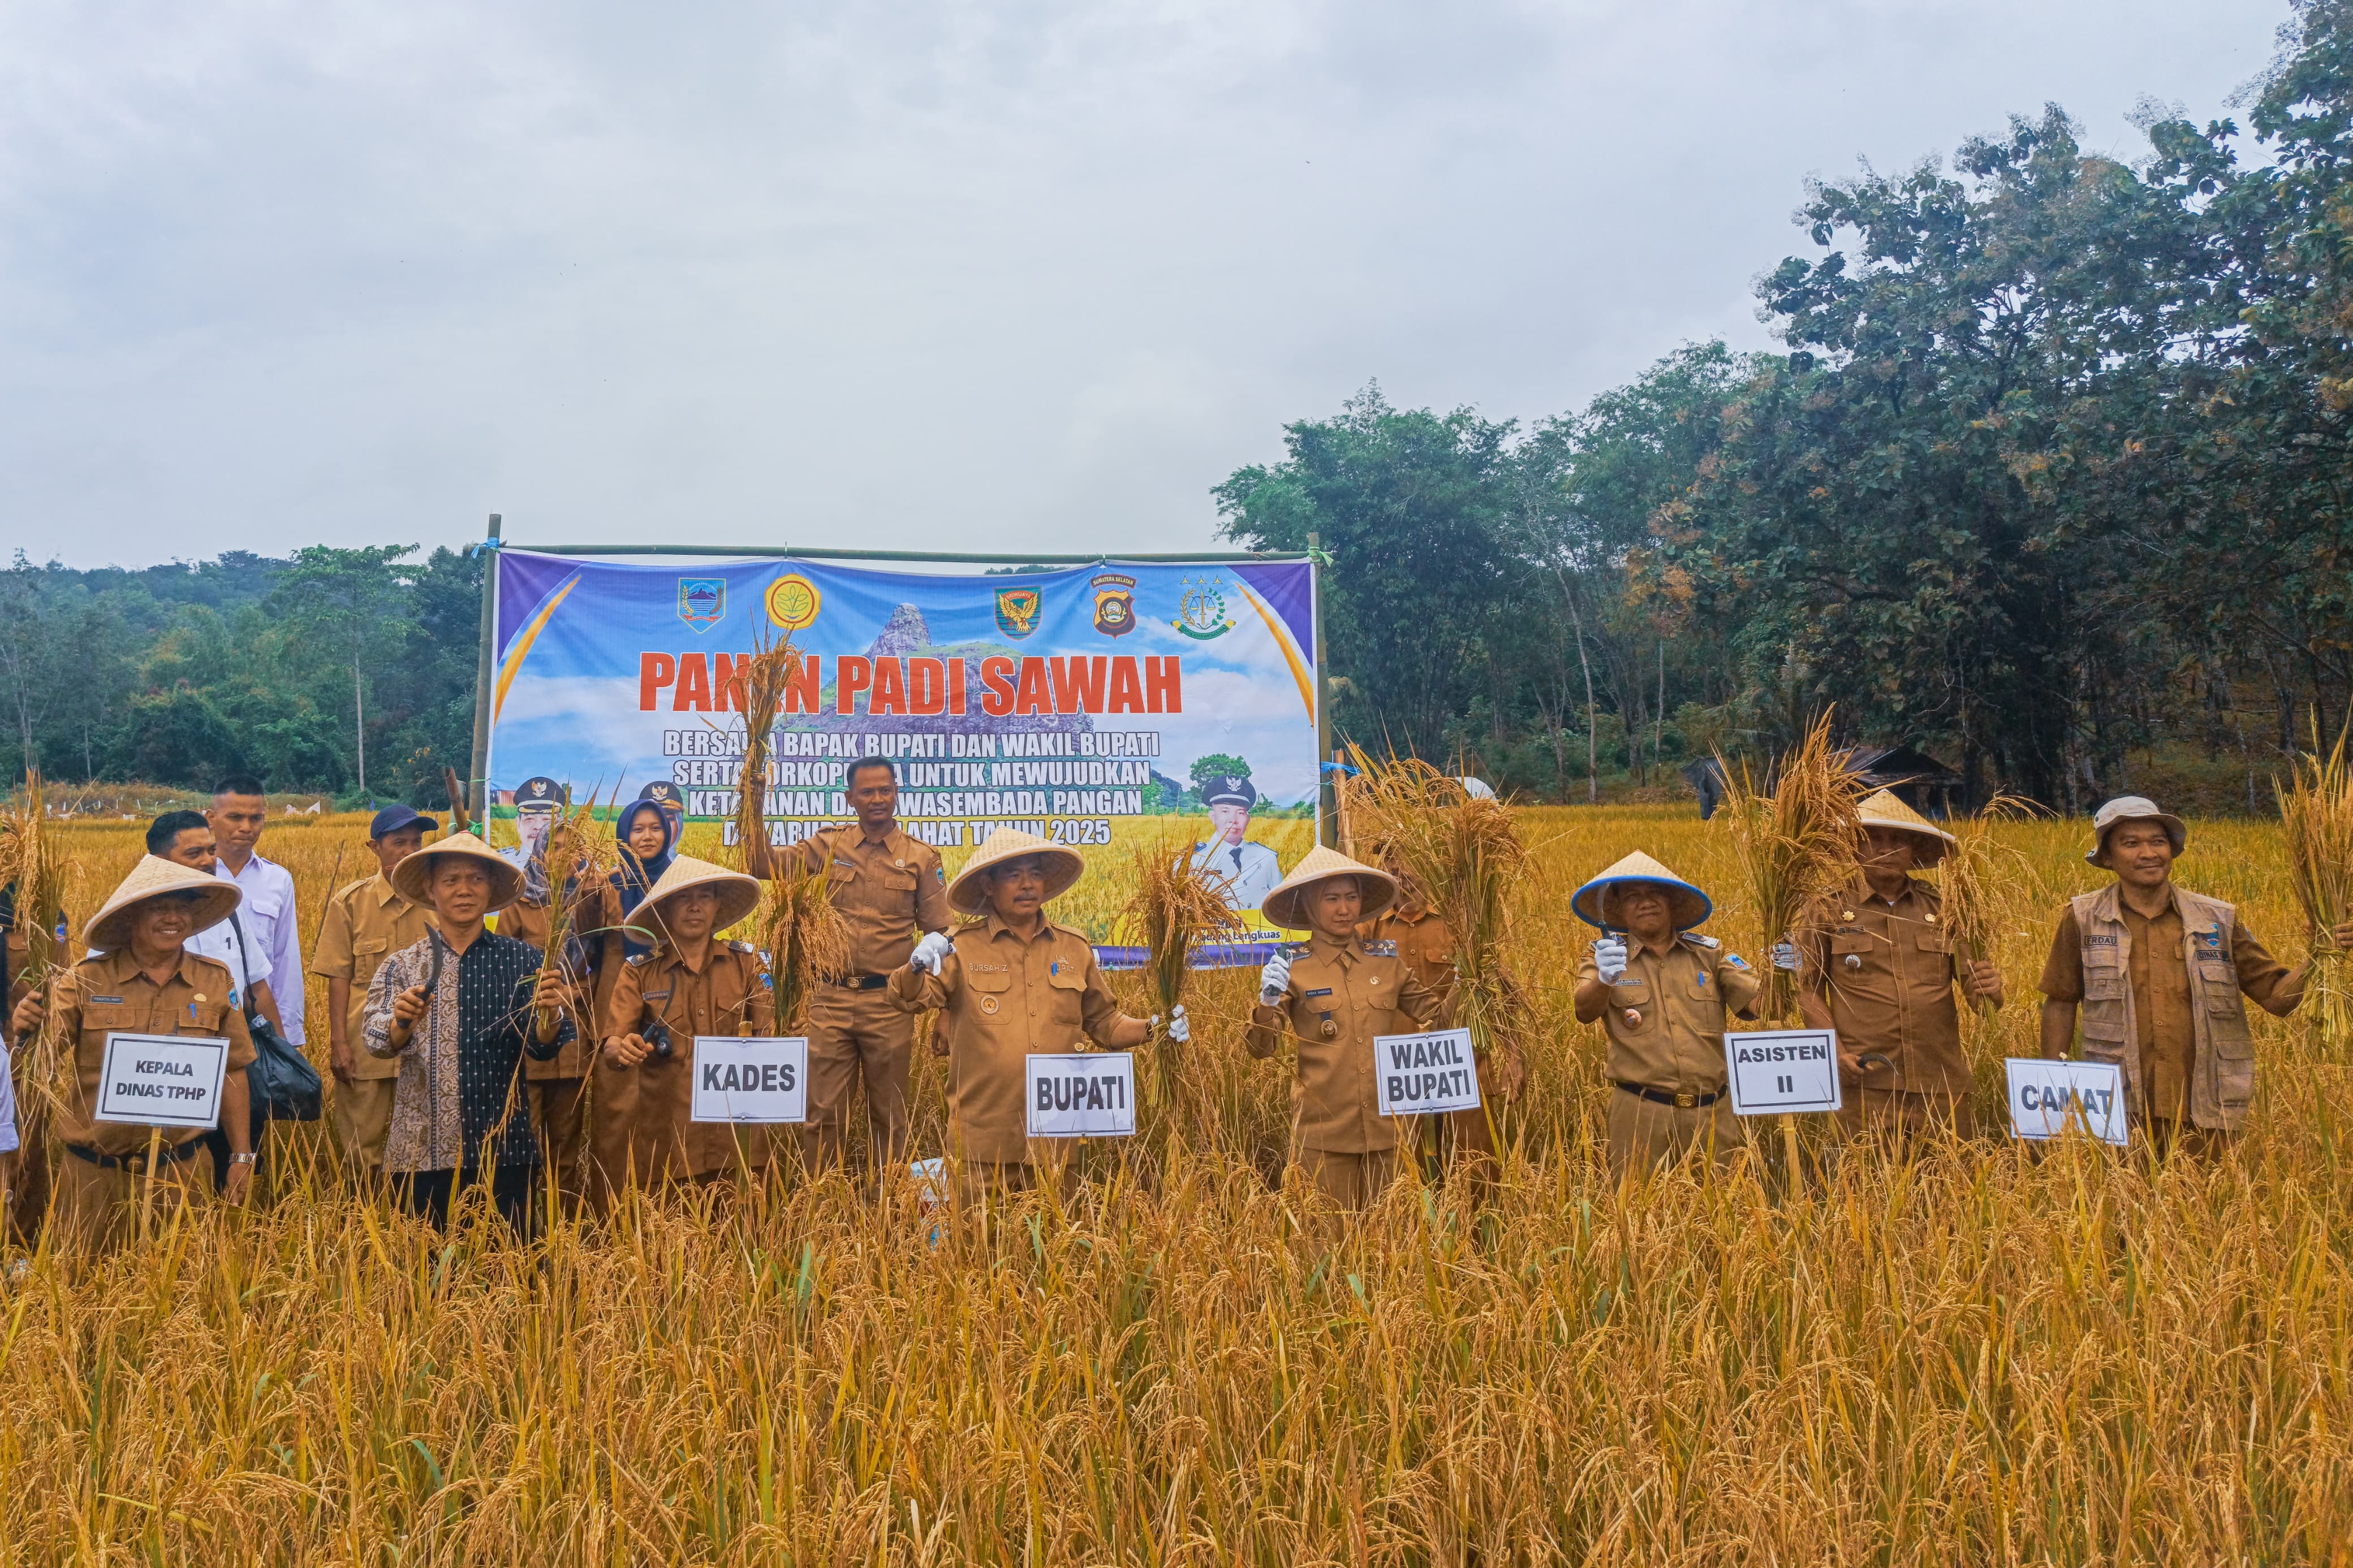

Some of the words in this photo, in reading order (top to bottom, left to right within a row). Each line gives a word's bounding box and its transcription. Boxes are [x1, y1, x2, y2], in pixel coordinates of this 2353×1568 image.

[1093, 576, 1115, 585] SUMATERA
[1115, 576, 1134, 585] SELATAN
[640, 651, 821, 714] PANN
[836, 655, 966, 715] PADI
[980, 655, 1183, 716] SAWAH
[664, 730, 779, 757] BERSAA
[783, 732, 860, 758] BAPAK
[864, 732, 946, 759] BUPATI
[951, 732, 997, 758] DAN
[1001, 732, 1076, 758] WAKIL
[1080, 731, 1160, 757] BUPATI
[909, 762, 988, 788] UNTUK
[991, 761, 1151, 787] MEWUJUDKAN
[892, 791, 1048, 817] WASEMBADA
[1053, 789, 1143, 815] PANGAN
[897, 820, 966, 846] AHAT
[1050, 819, 1111, 845] 2025
[969, 962, 999, 971] BURSAH
[1390, 1039, 1464, 1069] WAKIL
[1738, 1044, 1826, 1063] ASISTEN
[136, 1060, 193, 1076] KEPALA
[703, 1063, 795, 1091] KADES
[116, 1082, 164, 1098] DINAS
[167, 1086, 206, 1100] TPHP
[1036, 1075, 1125, 1111] BUPATI
[1387, 1068, 1471, 1102] BUPATI
[1777, 1075, 1794, 1093] II
